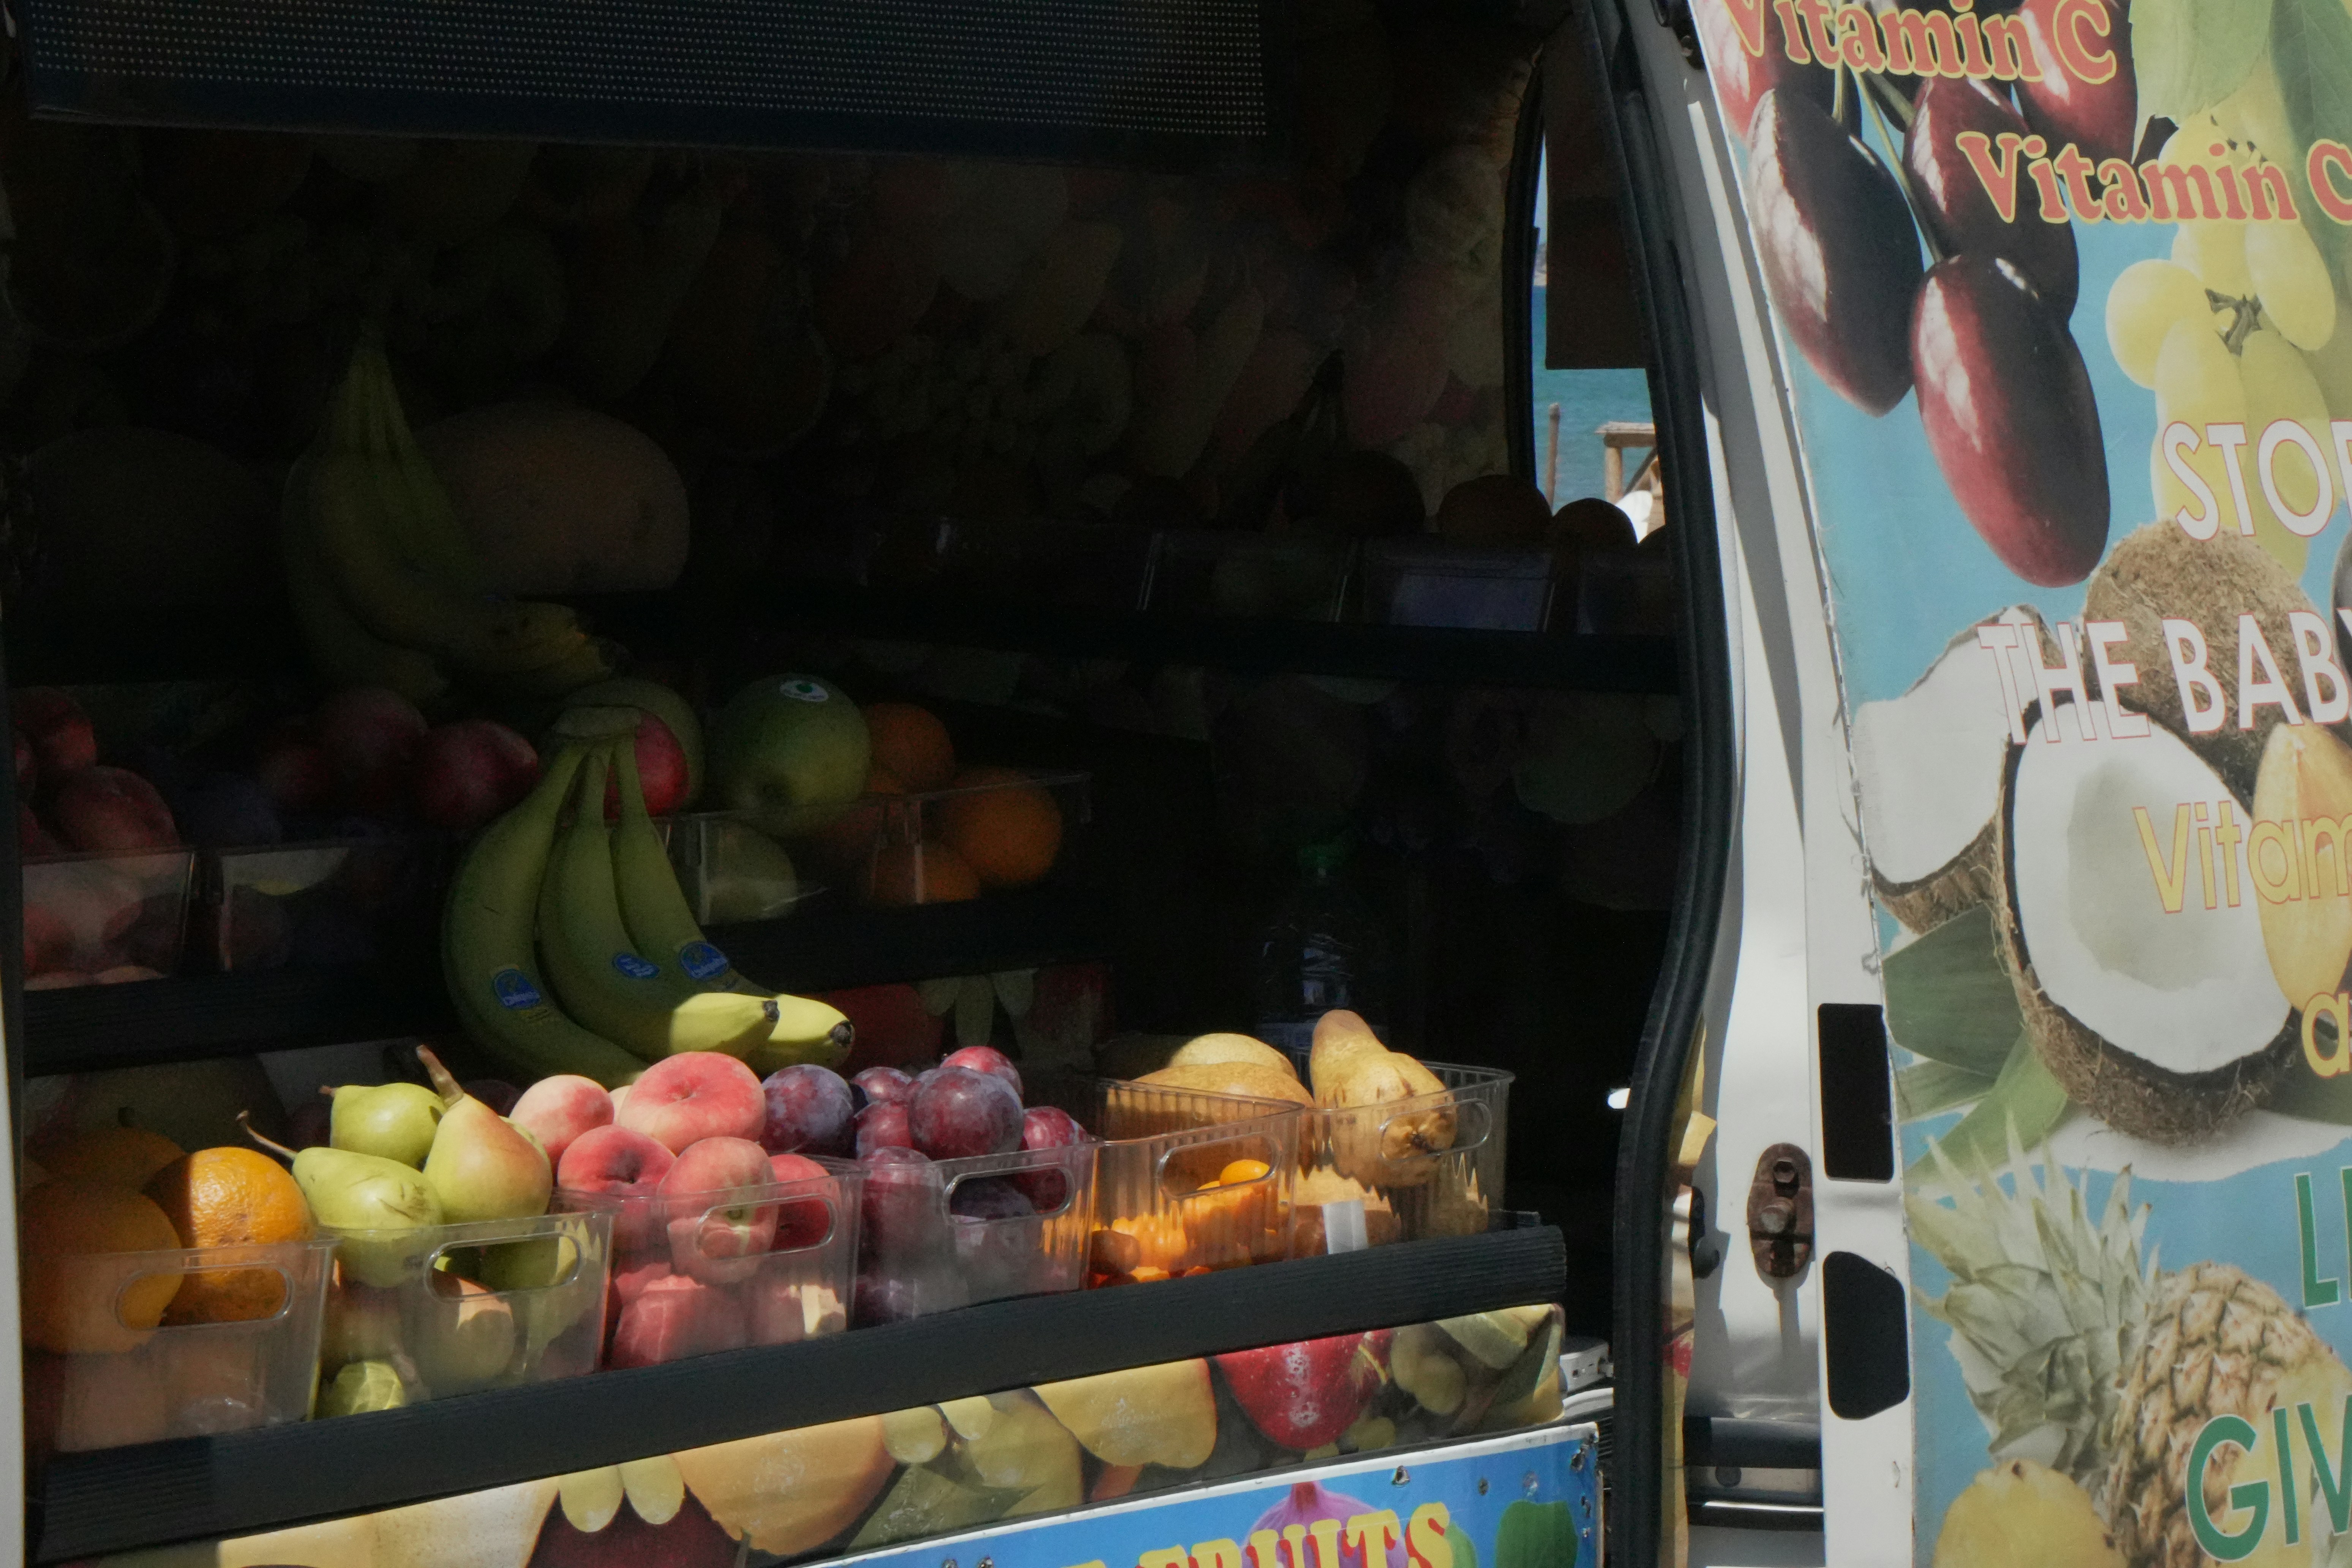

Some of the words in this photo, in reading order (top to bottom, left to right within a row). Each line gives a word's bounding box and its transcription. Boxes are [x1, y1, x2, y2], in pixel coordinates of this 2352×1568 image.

[1722, 0, 2044, 82] Vitamin
[2053, 0, 2117, 84] C
[1956, 131, 2301, 224] Vitamin
[2306, 138, 2352, 225] C
[1977, 620, 2151, 744] THE
[2161, 607, 2352, 735] BAB
[1135, 1501, 1453, 1568] ITS
